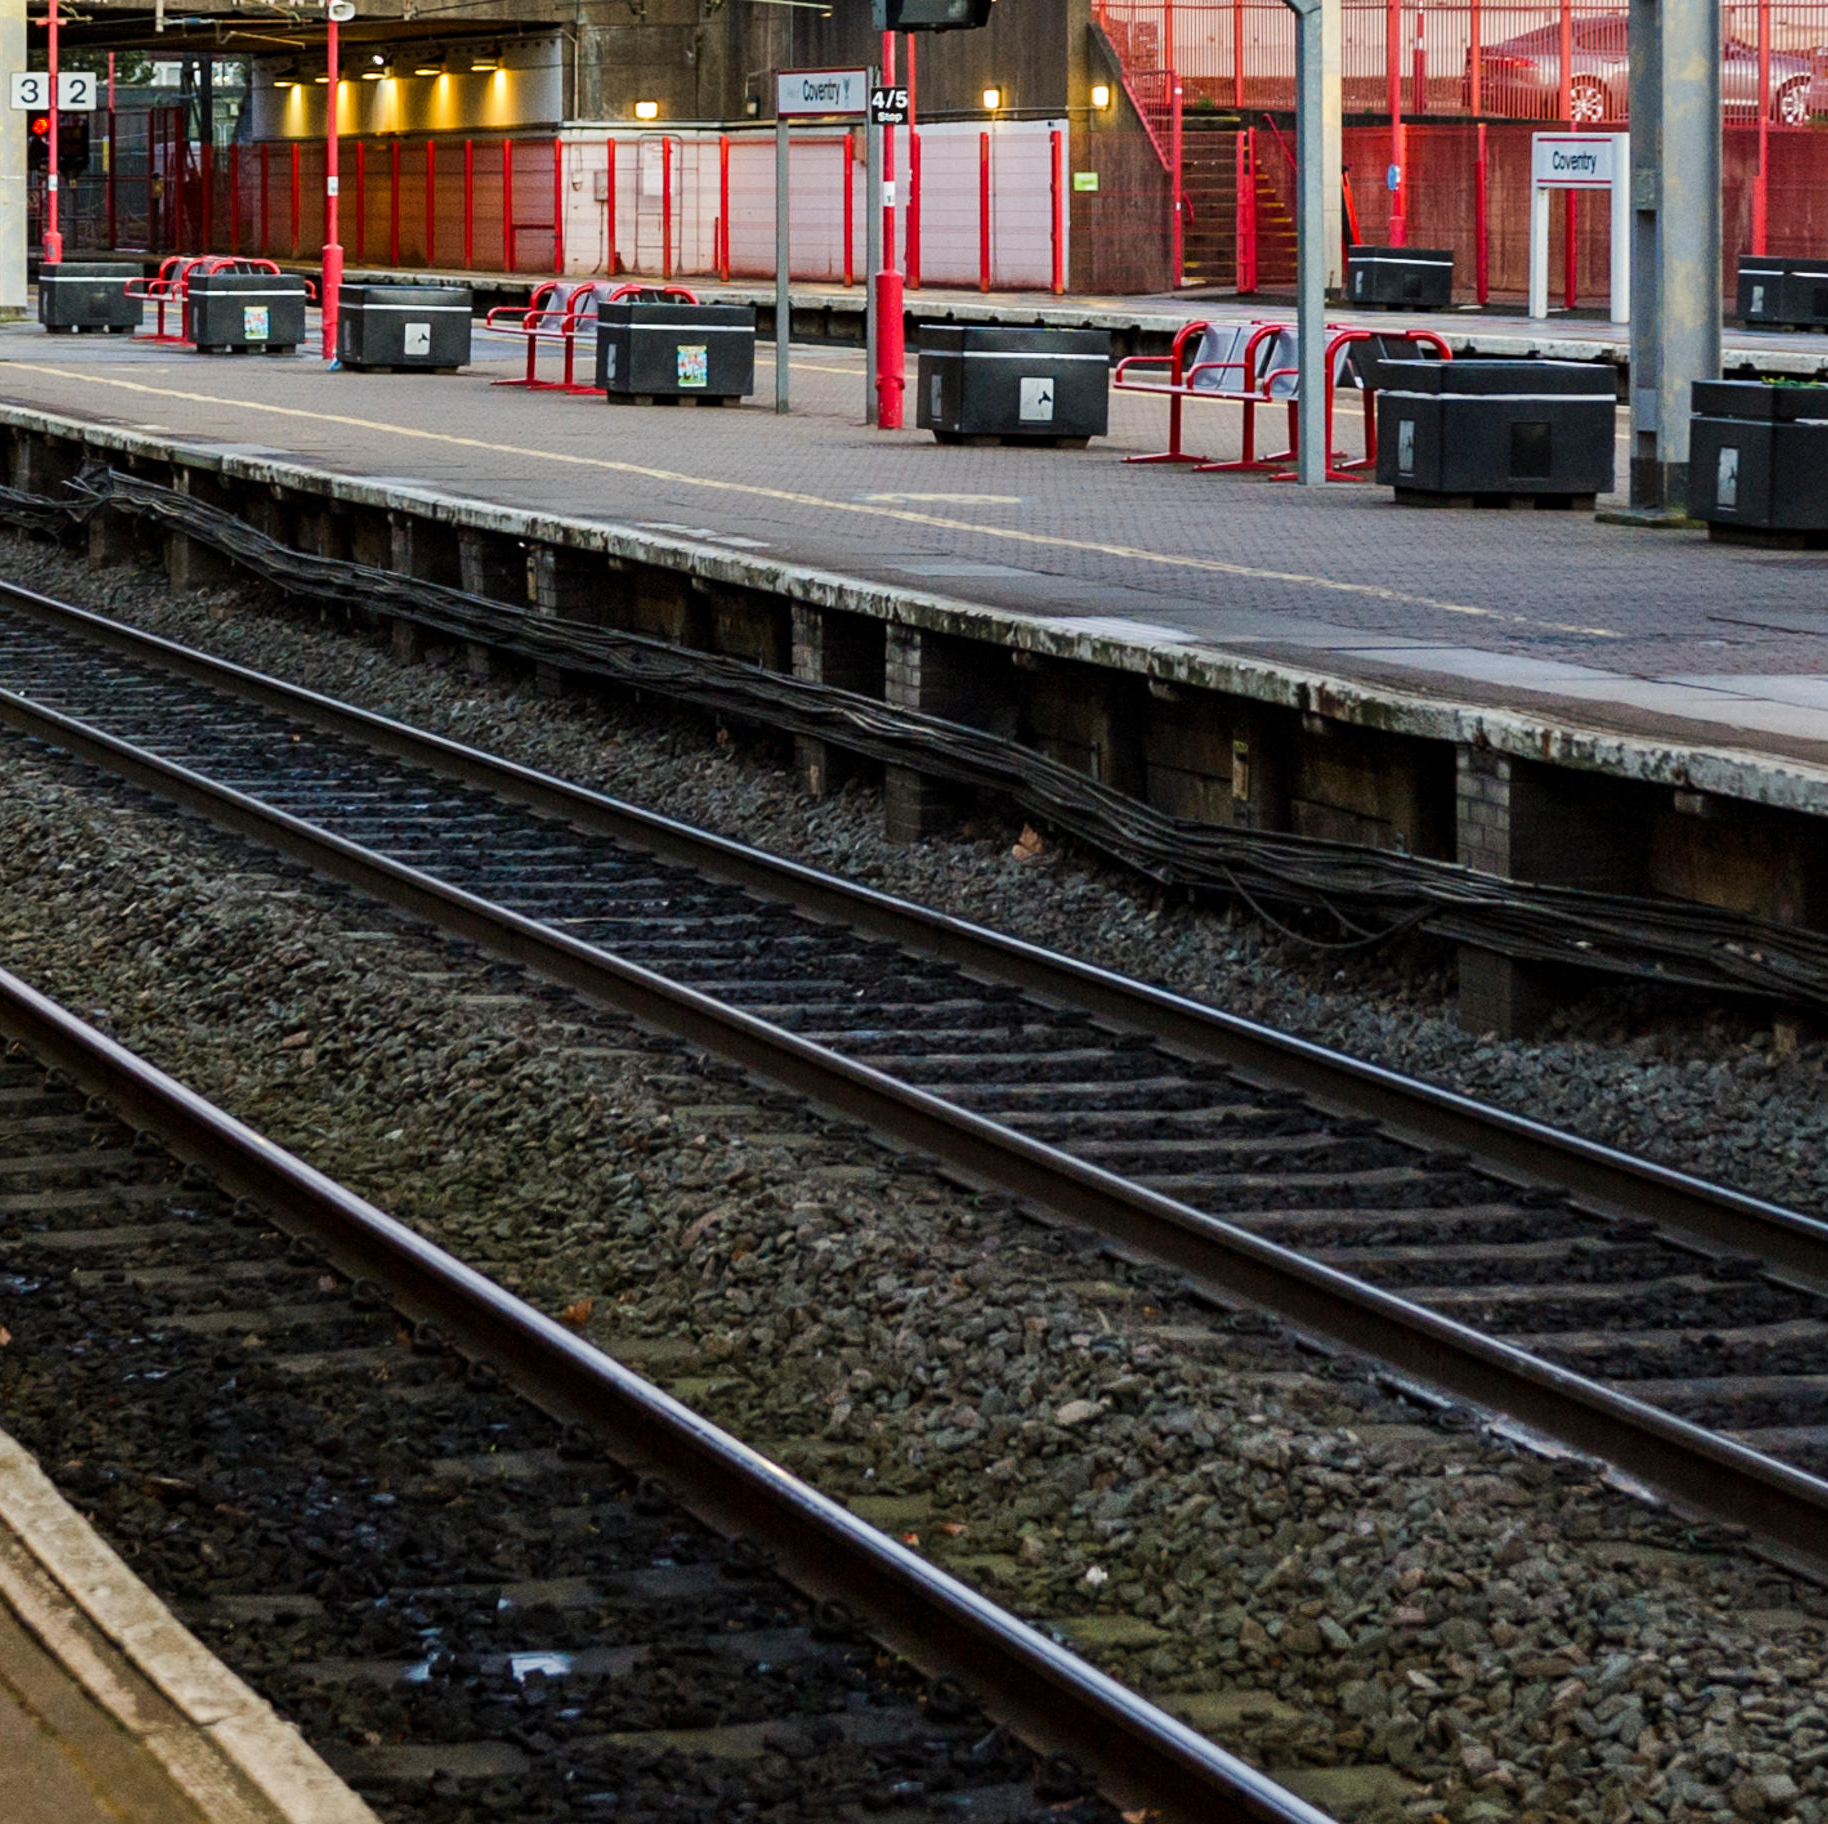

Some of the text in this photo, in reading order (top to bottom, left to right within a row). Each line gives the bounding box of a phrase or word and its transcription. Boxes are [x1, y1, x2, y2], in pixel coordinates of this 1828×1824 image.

[20, 78, 39, 104] 3
[69, 79, 87, 104] 2
[802, 78, 841, 106] Coventry
[872, 89, 909, 109] 4/5
[1552, 150, 1598, 175] Coventry
